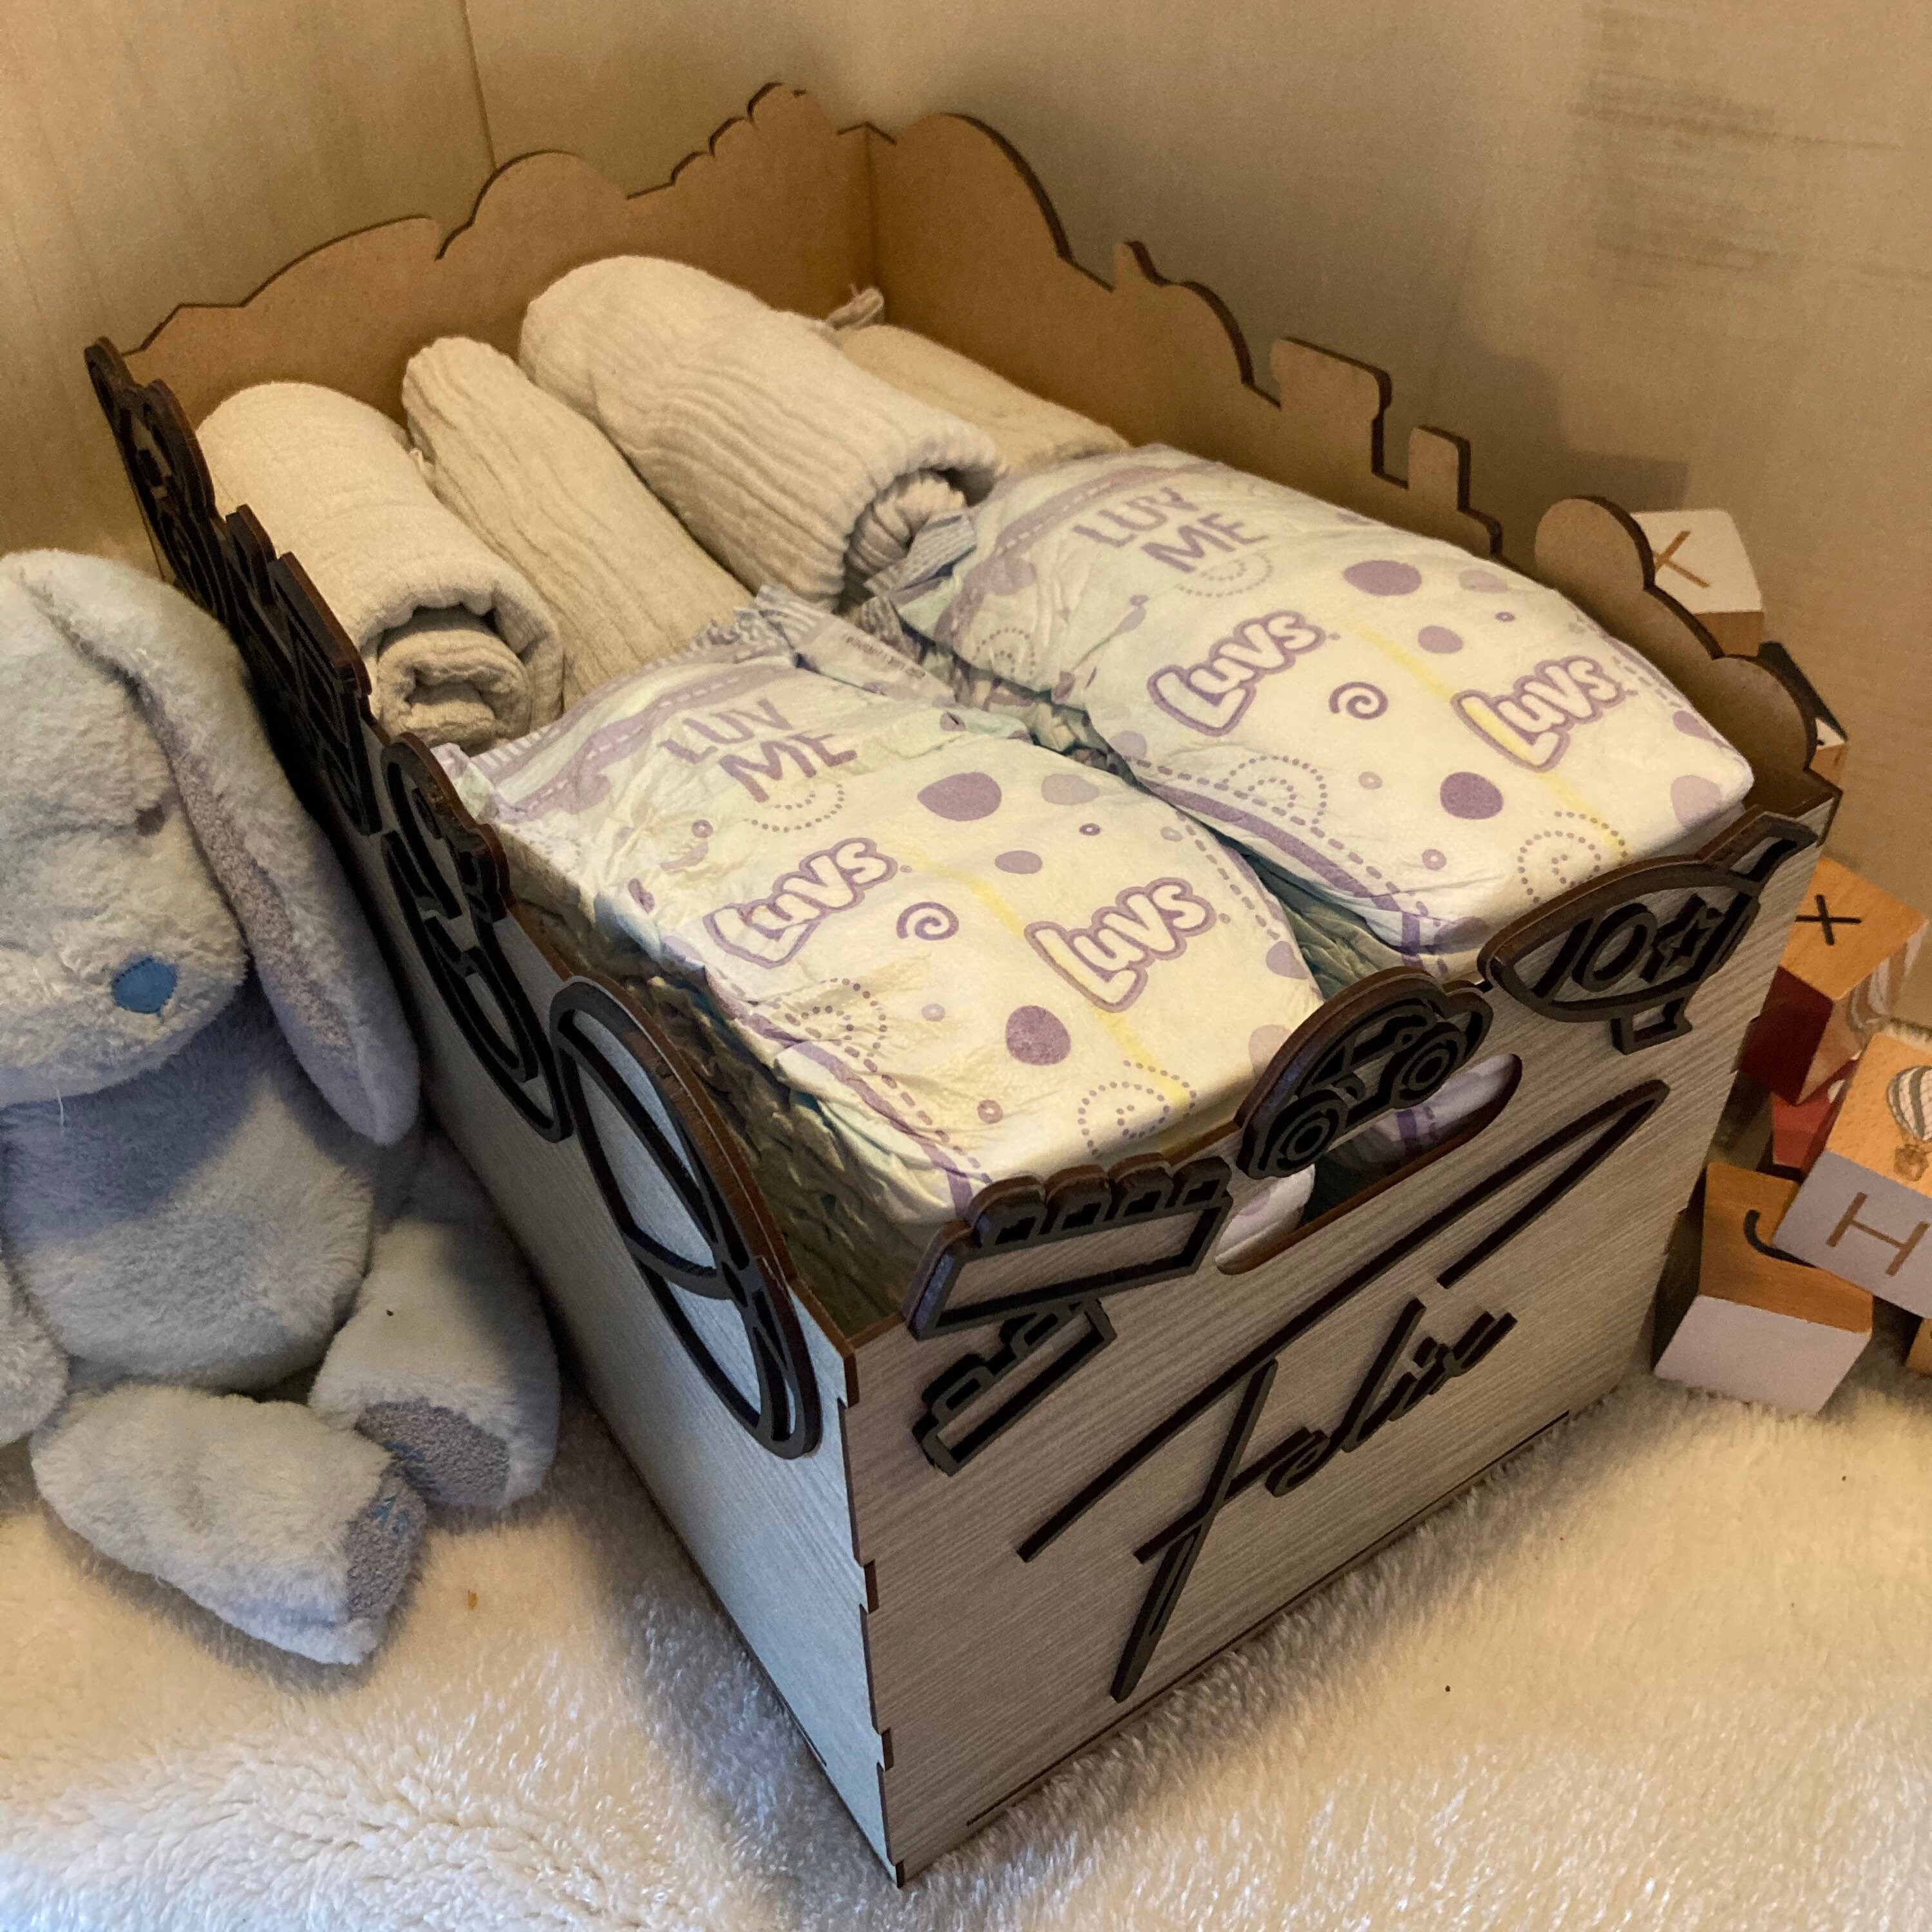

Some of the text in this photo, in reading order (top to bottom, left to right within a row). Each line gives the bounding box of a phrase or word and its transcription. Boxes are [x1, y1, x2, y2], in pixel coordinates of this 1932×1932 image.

[1141, 512, 1269, 573] ME
[661, 698, 794, 764] LUV
[1146, 610, 1327, 737] Luvs
[1450, 655, 1625, 772] Luvs
[719, 733, 858, 802] ME
[703, 837, 898, 969] Luvs
[1024, 876, 1216, 1013] Luvs
[1017, 1079, 1670, 1703] Felix
